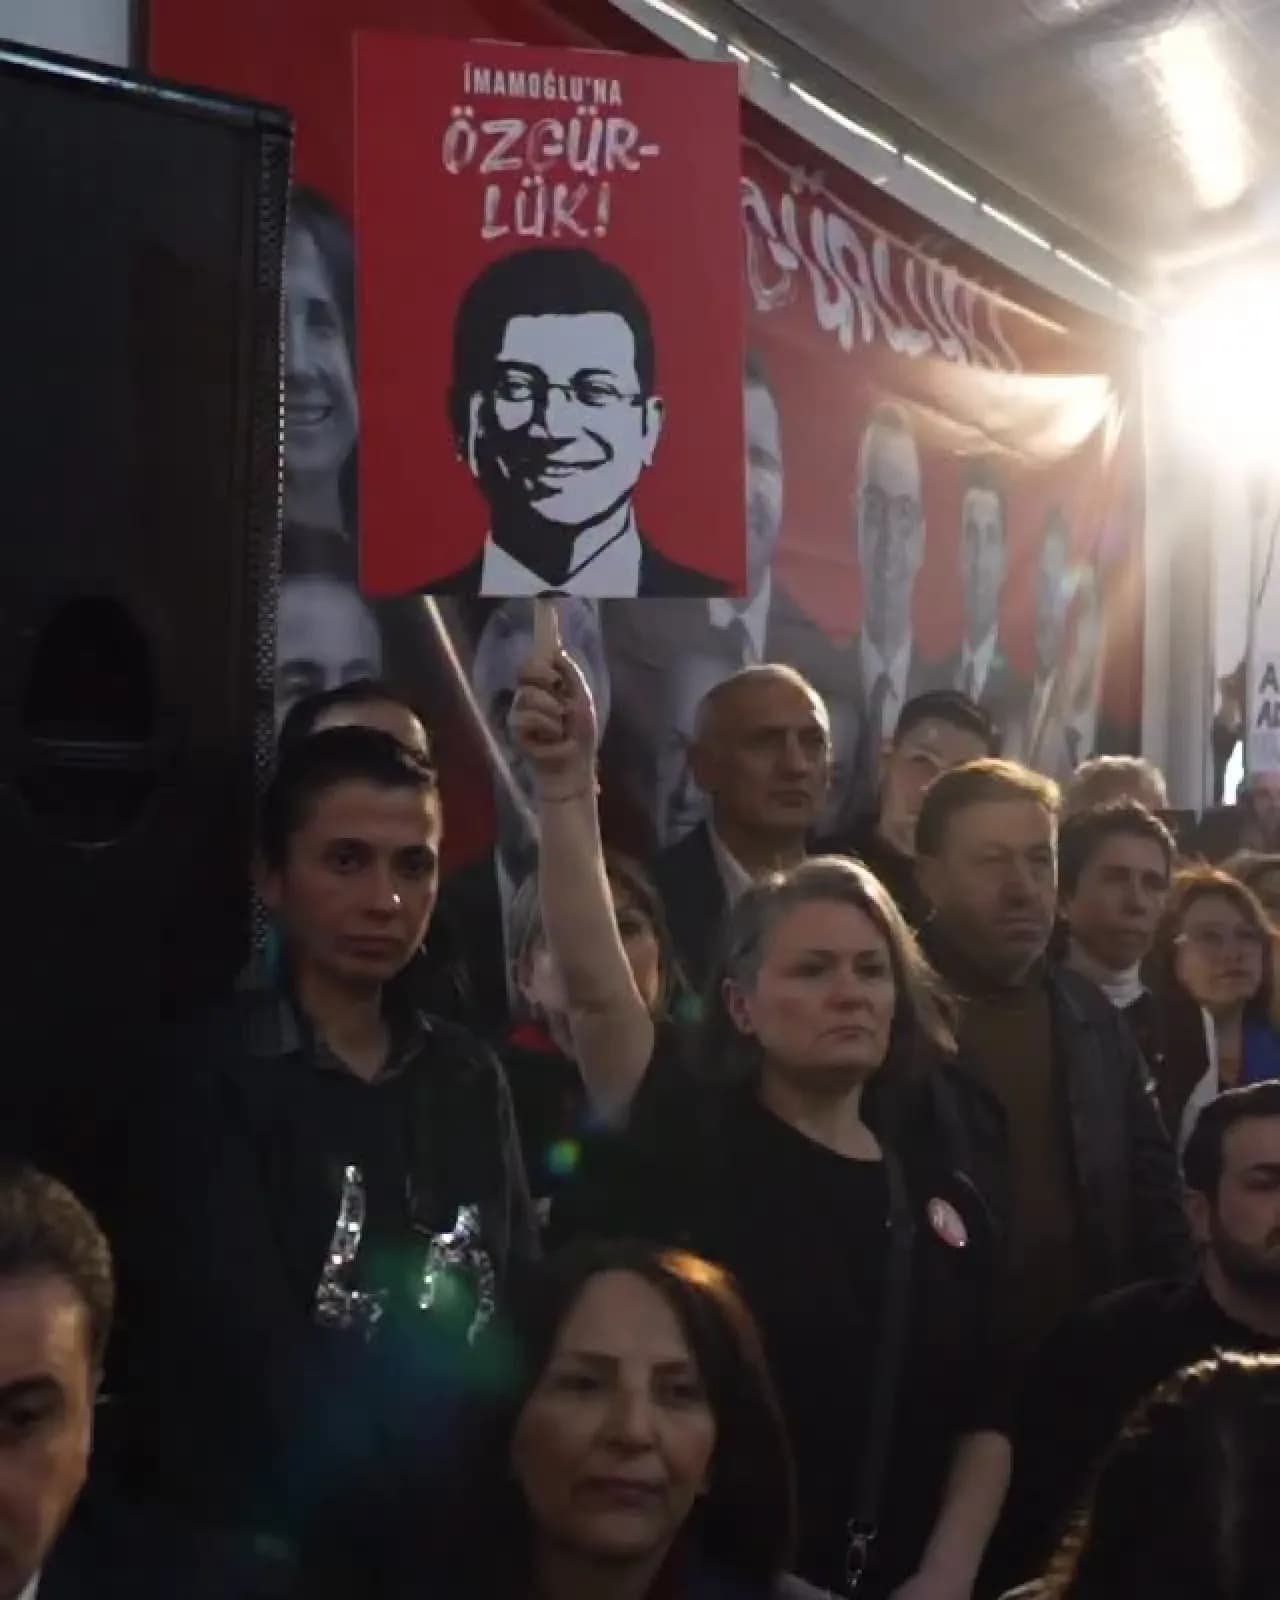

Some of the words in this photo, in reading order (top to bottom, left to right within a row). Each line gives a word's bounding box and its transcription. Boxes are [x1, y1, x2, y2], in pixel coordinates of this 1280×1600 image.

[463, 61, 622, 107] İMAMOĞLU'NA
[442, 105, 660, 177] ÖZGÜR-
[481, 174, 611, 240] LÜK!
